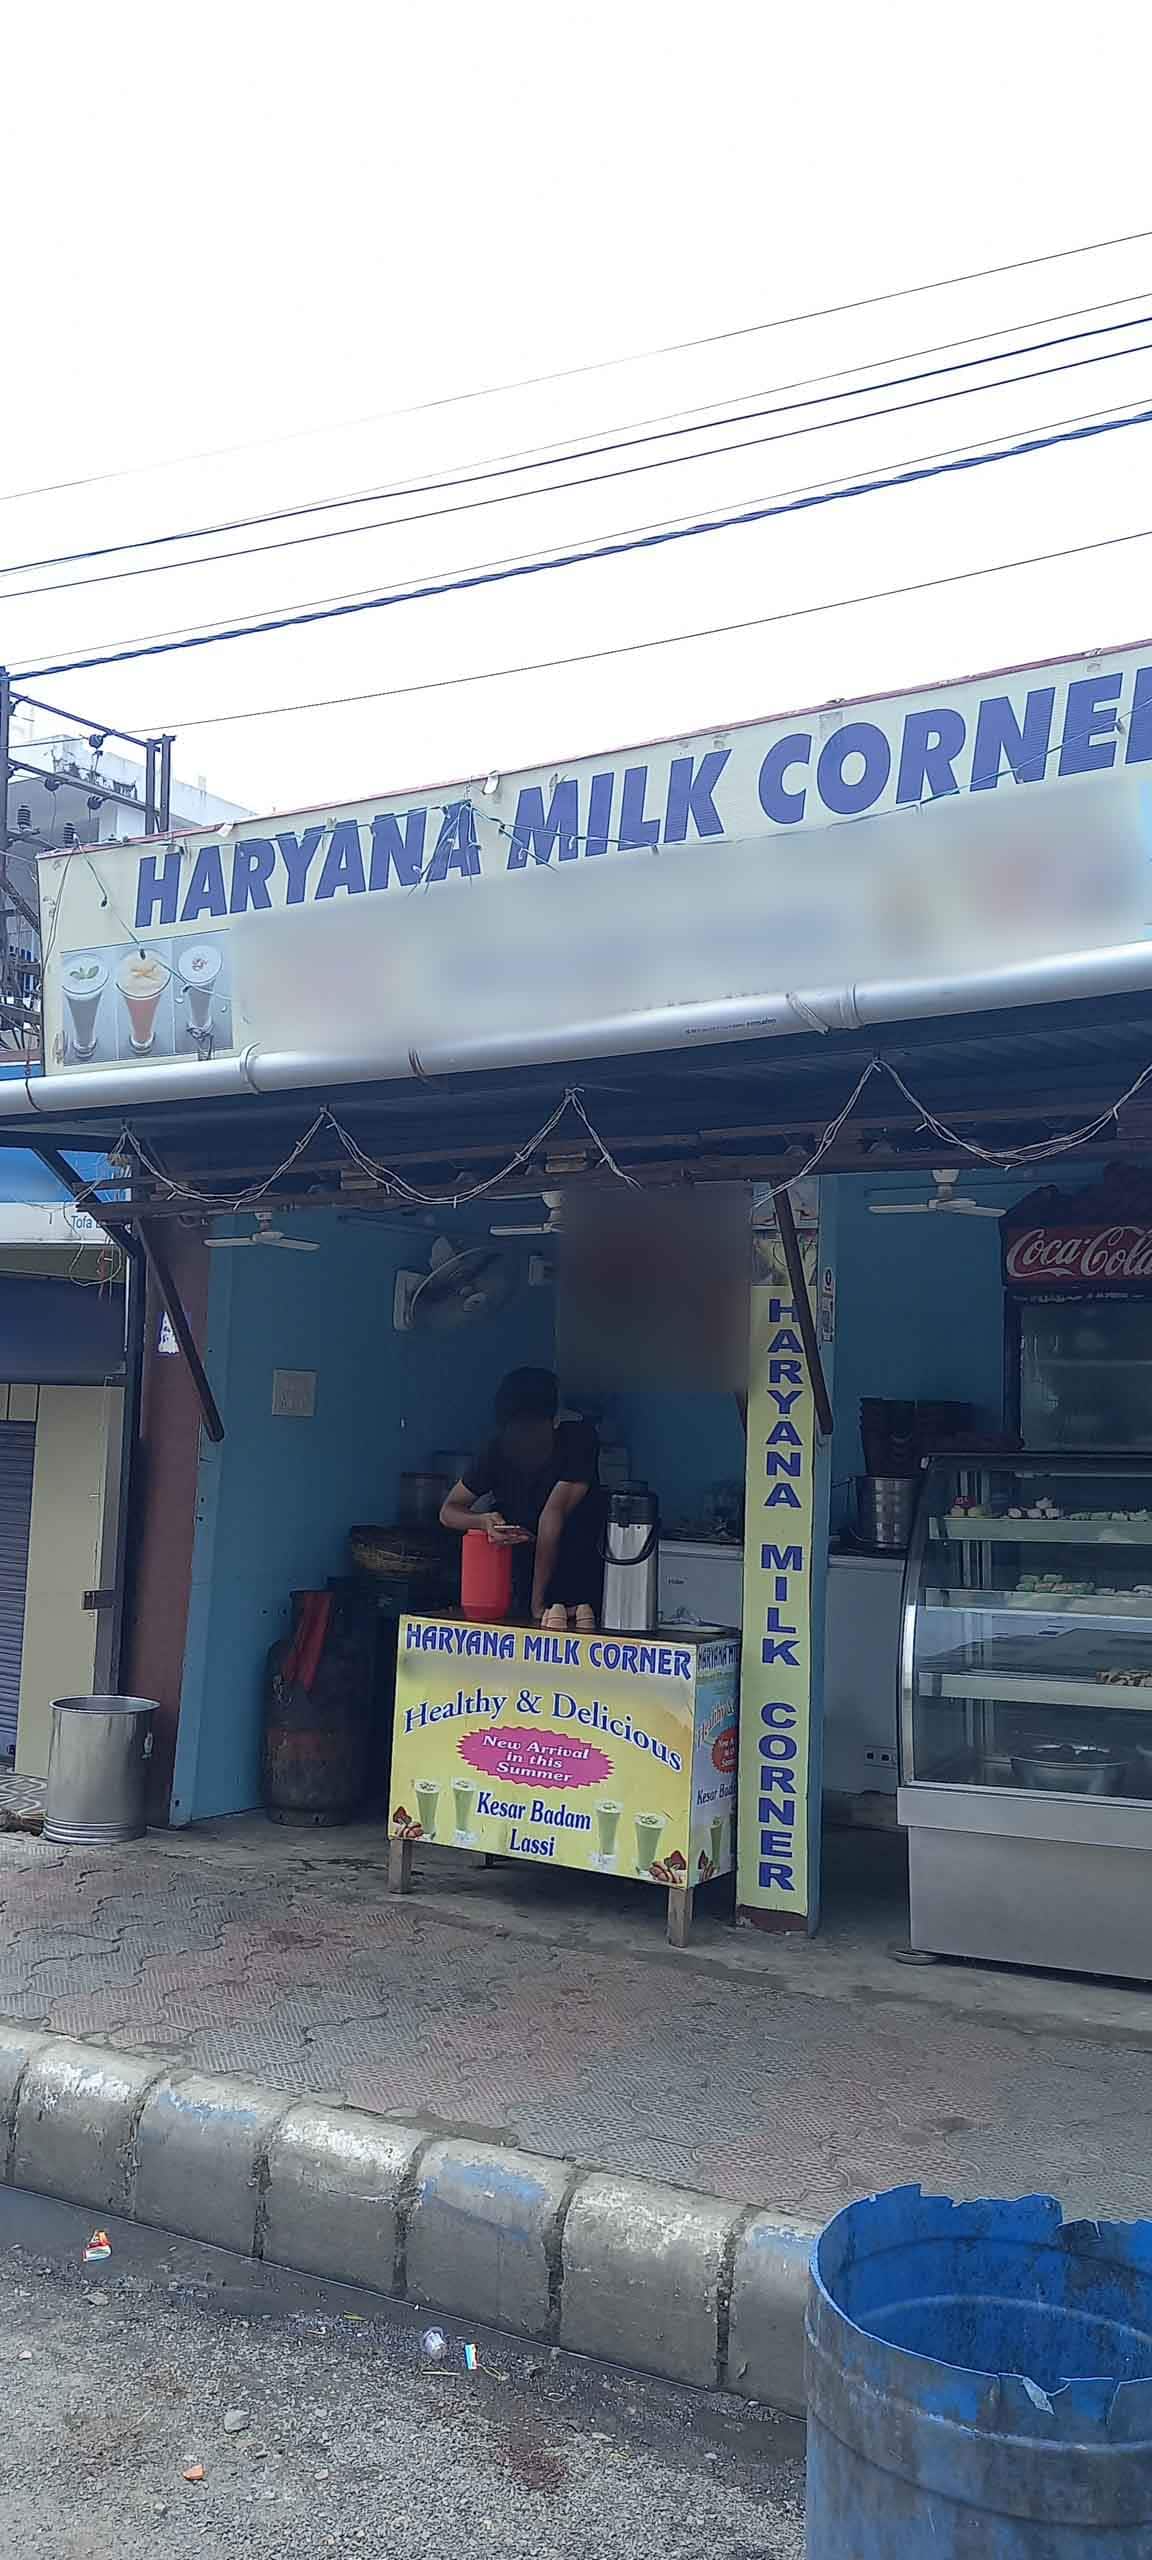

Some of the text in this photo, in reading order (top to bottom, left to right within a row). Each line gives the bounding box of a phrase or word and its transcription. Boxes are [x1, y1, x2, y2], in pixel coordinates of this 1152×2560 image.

[135, 801, 482, 928] HARYANA
[507, 749, 732, 870] MILK
[758, 1298, 804, 1891] HARYANA MILK CORNER
[406, 1623, 691, 1680] HARYANA MILK CORNER
[405, 1687, 507, 1733] Healthy
[516, 1689, 542, 1714] &
[552, 1692, 682, 1771] Delicious
[482, 1735, 590, 1760] New Arrival
[496, 1762, 574, 1782] Summer
[506, 1751, 563, 1769] in this
[477, 1791, 592, 1830] Kesar Badam
[510, 1828, 555, 1857] Lassi
